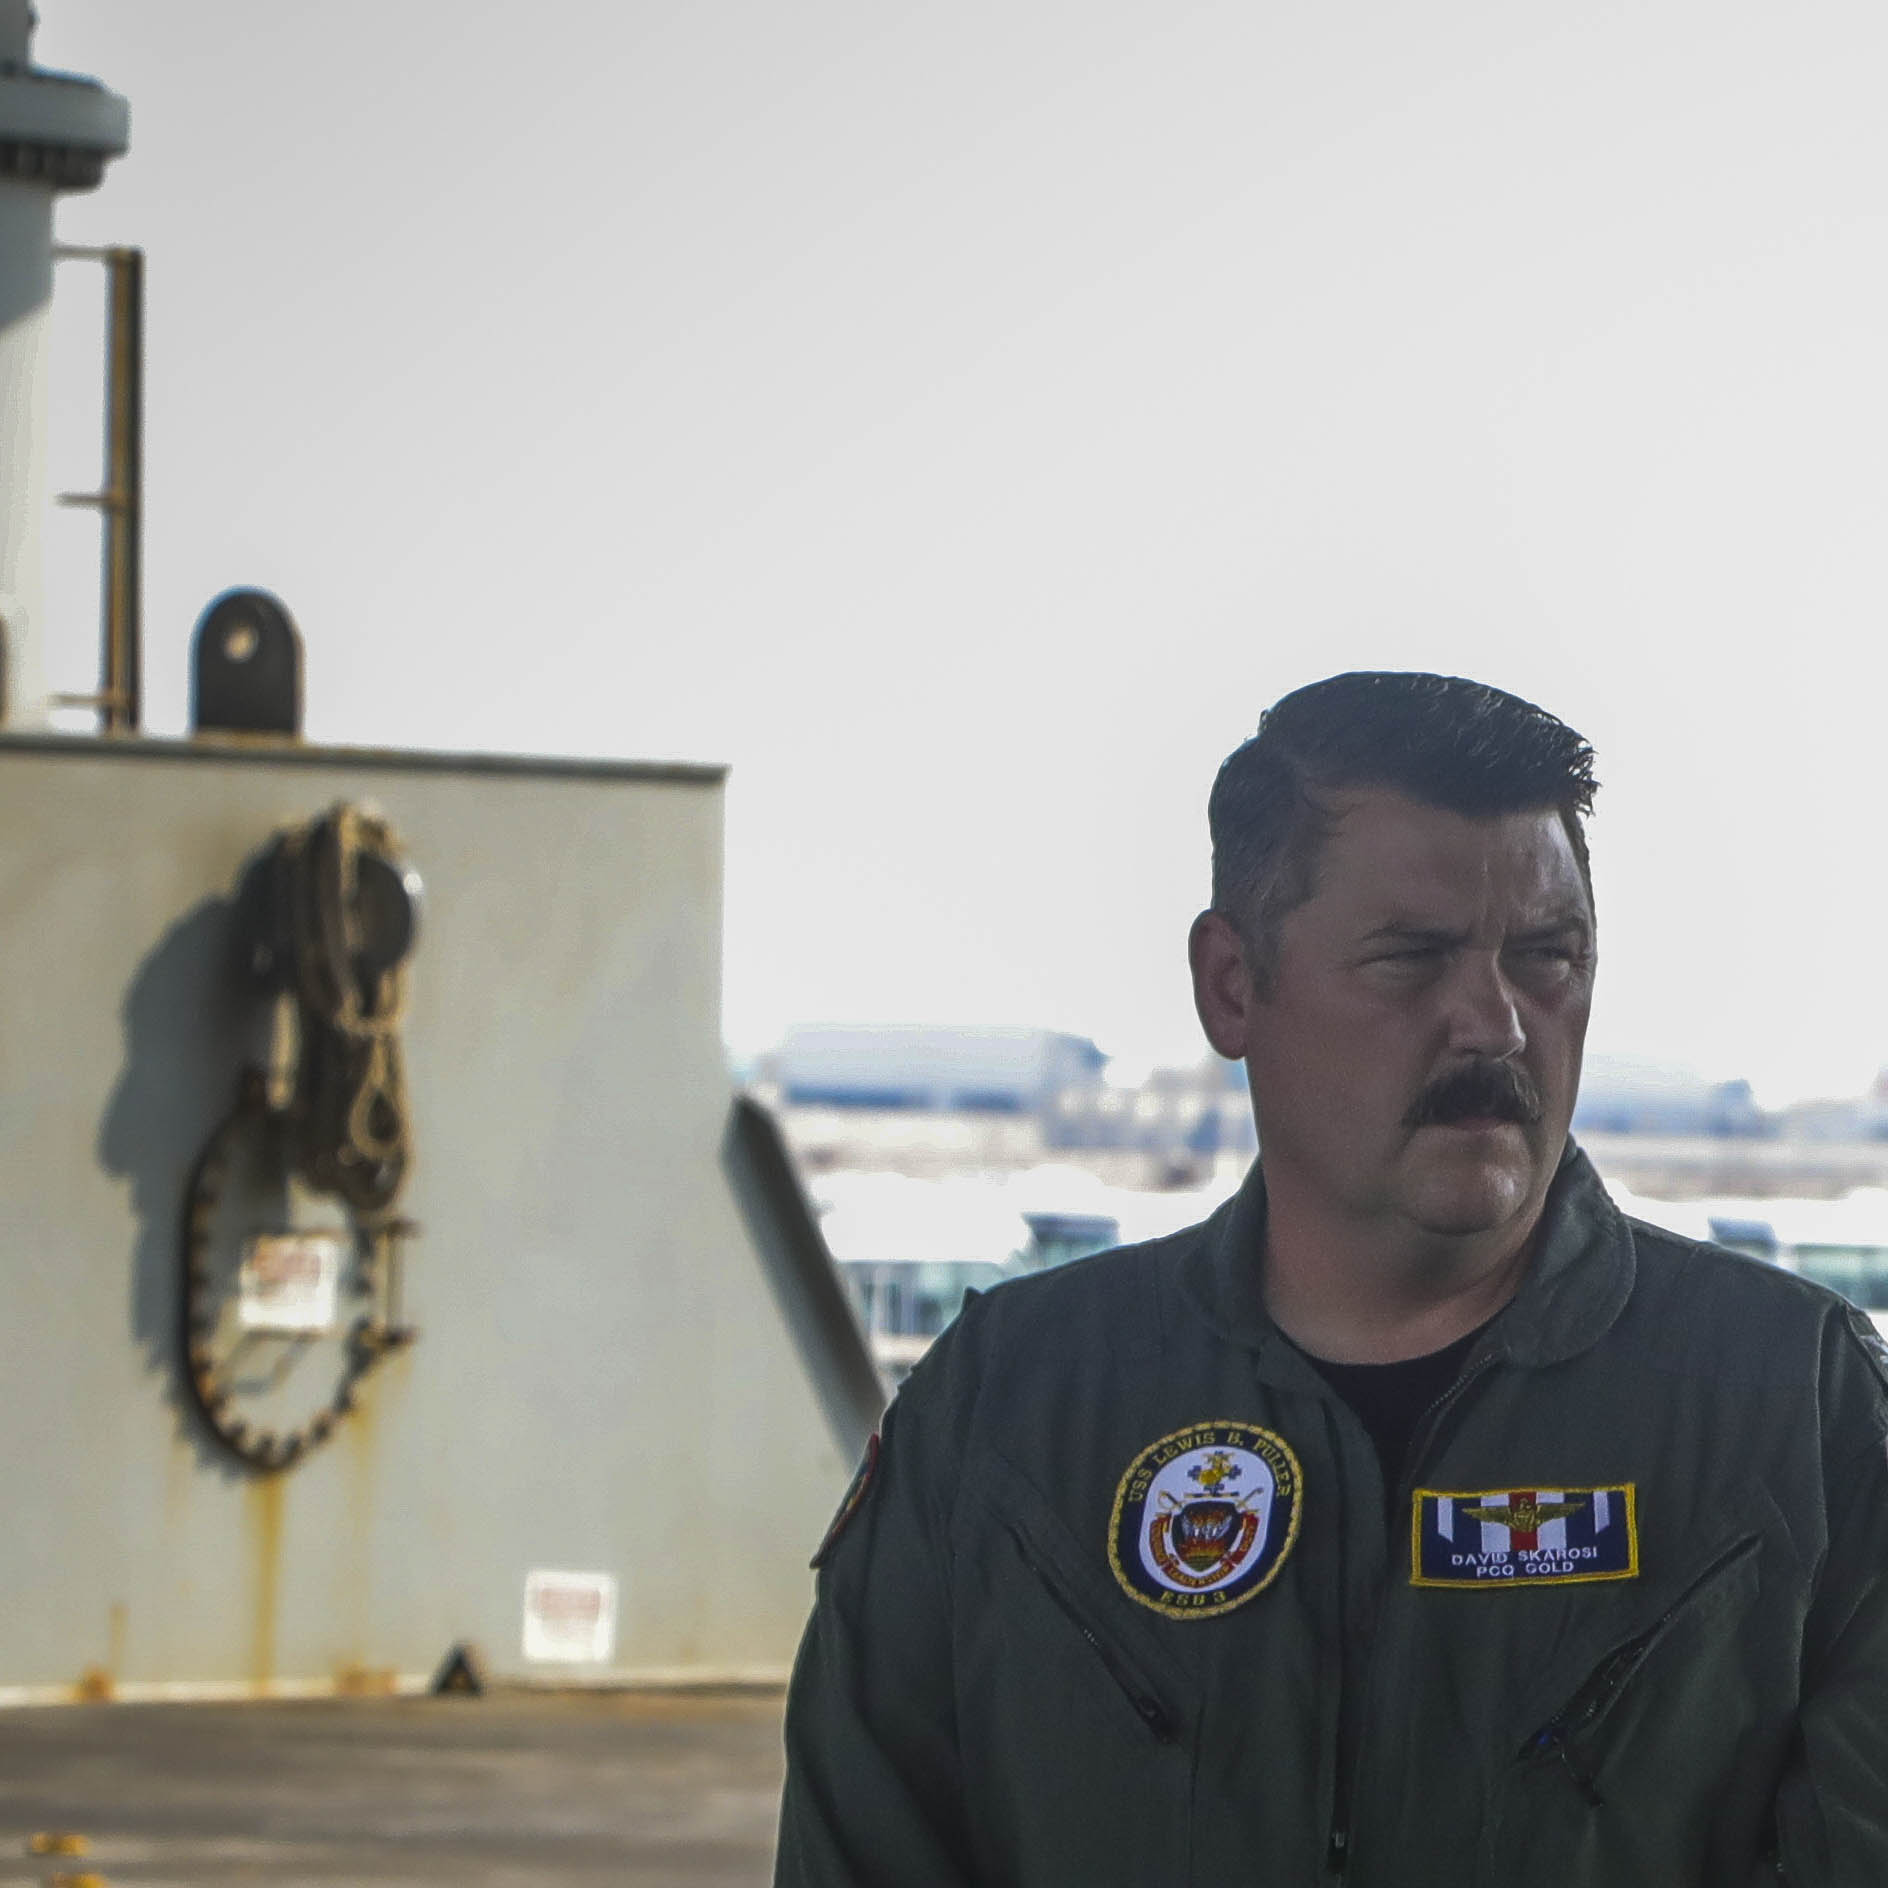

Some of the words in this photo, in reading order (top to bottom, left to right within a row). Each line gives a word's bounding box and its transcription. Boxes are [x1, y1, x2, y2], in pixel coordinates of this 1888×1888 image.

[1128, 1468, 1153, 1502] USS
[1154, 1432, 1216, 1464] LEWIS
[1227, 1431, 1244, 1446] B.
[1451, 1552, 1508, 1567] DAVID
[1518, 1546, 1598, 1562] SKAROSI
[1525, 1561, 1575, 1574] GOLD
[1214, 1591, 1227, 1604] 3
